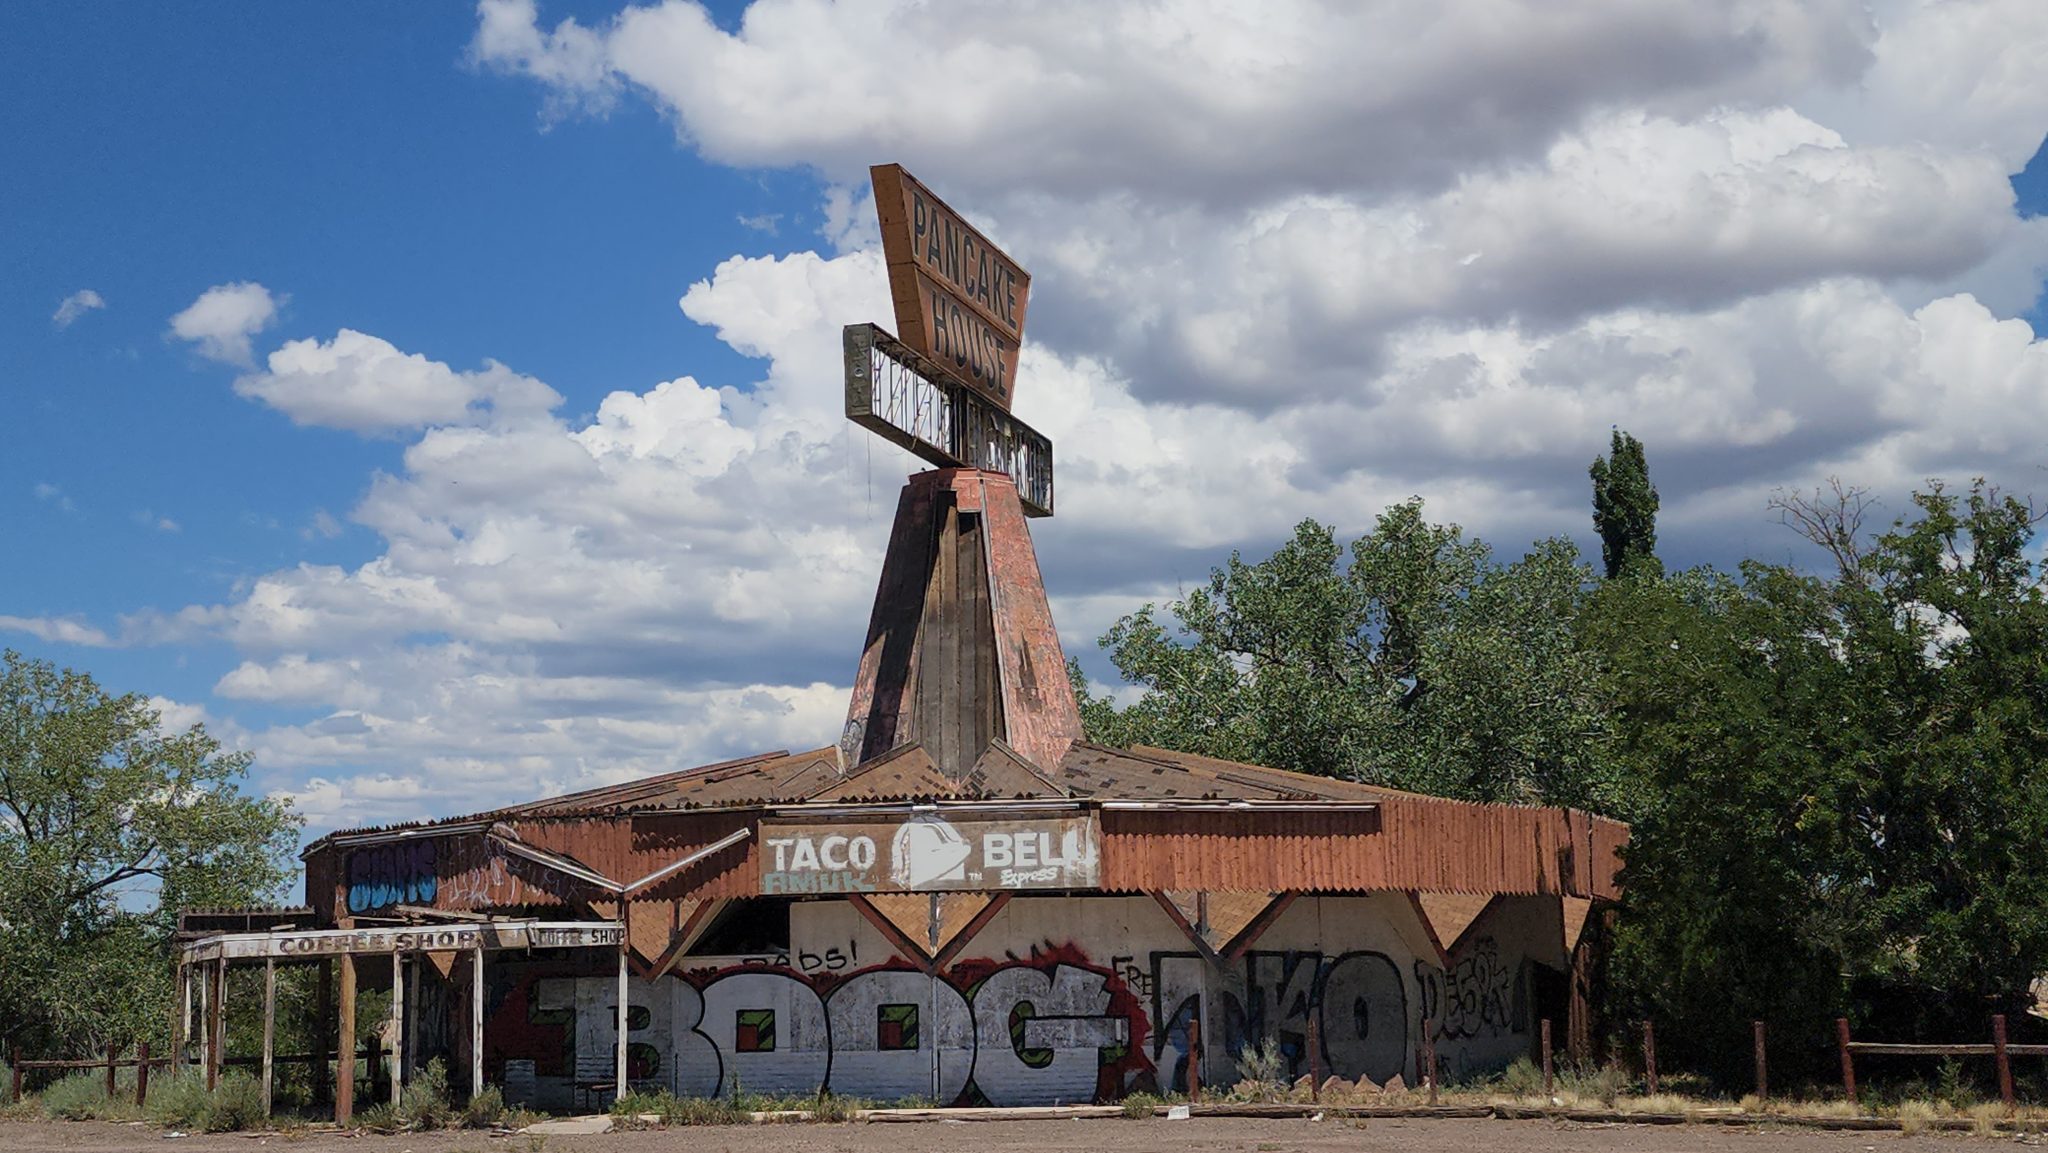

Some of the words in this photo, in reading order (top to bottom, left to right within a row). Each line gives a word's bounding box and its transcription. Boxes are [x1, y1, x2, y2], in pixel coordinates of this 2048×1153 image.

[912, 190, 1018, 332] PANCAKE
[931, 289, 1008, 400] HOUSE
[766, 835, 876, 872] TACO
[395, 931, 475, 951] SHOP
